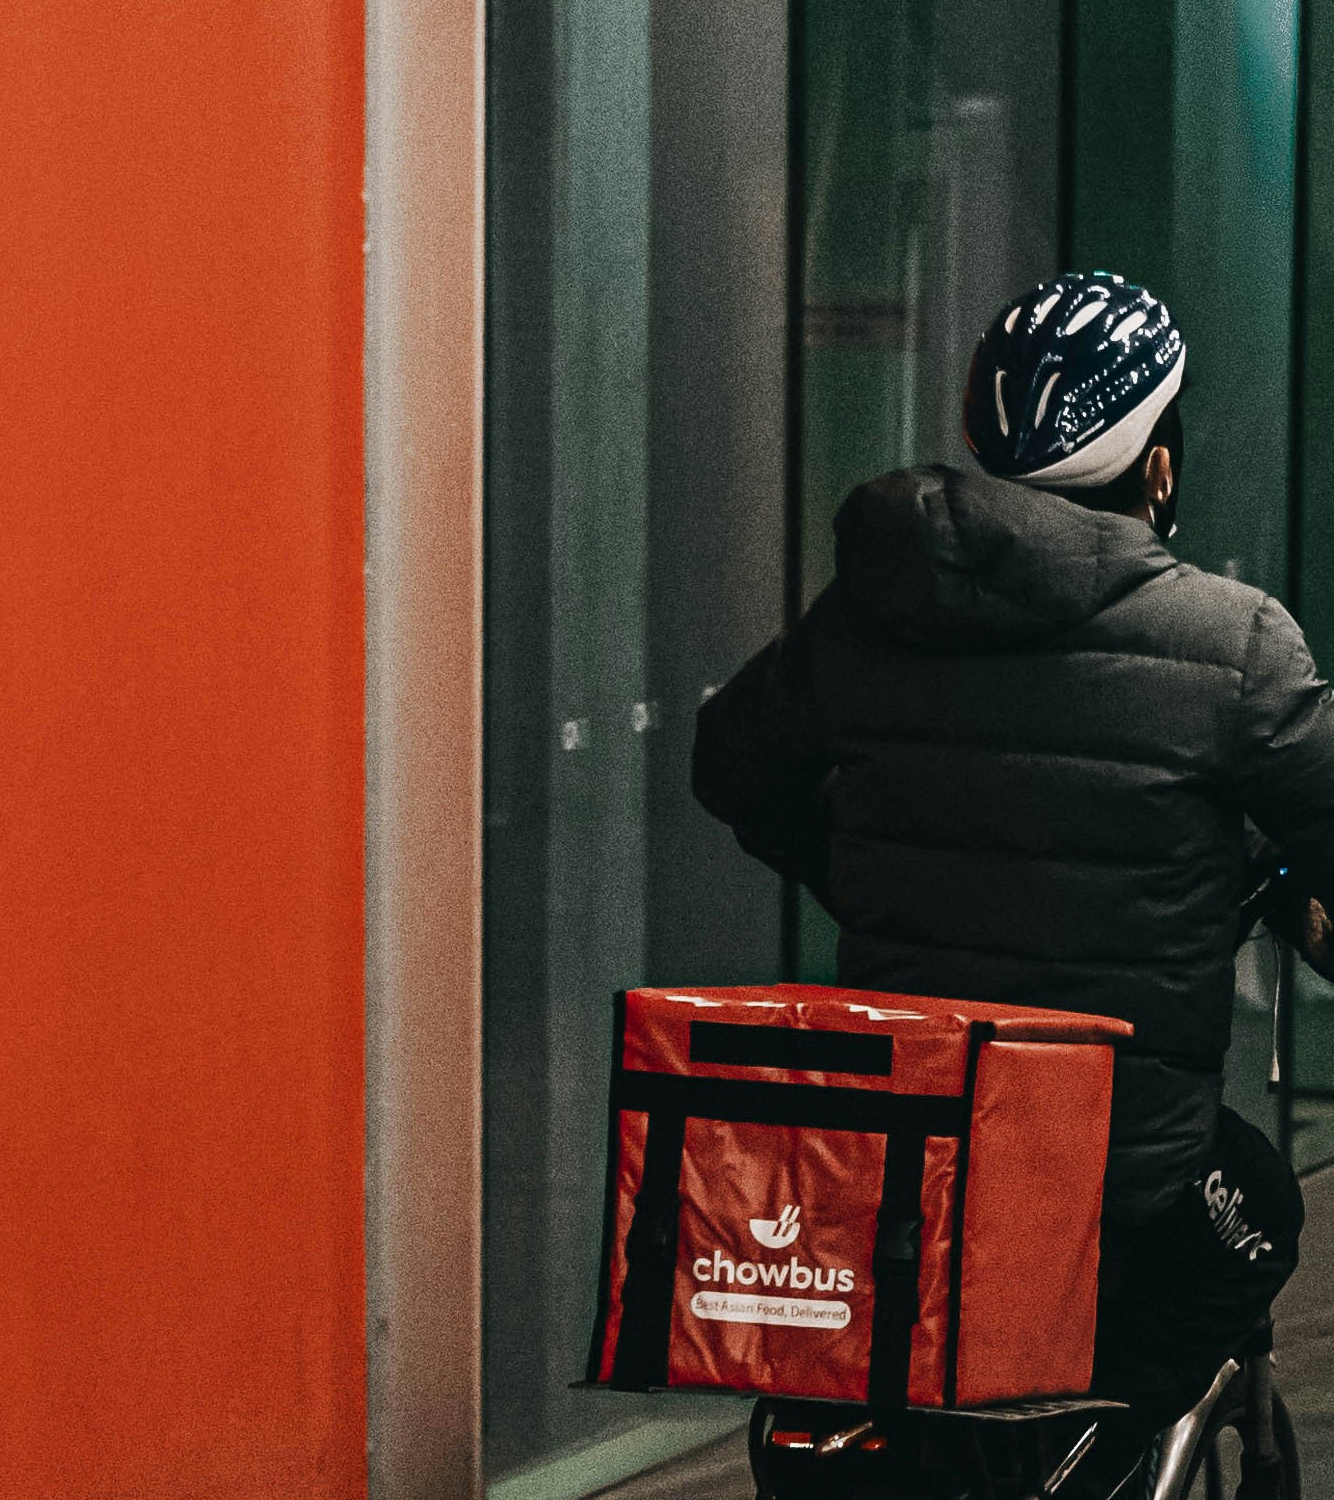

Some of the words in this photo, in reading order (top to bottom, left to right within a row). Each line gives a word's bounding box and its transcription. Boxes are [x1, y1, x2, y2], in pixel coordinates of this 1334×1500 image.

[692, 1250, 855, 1293] chowbus
[756, 1303, 788, 1318] Food,
[791, 1306, 847, 1322] Delivered
